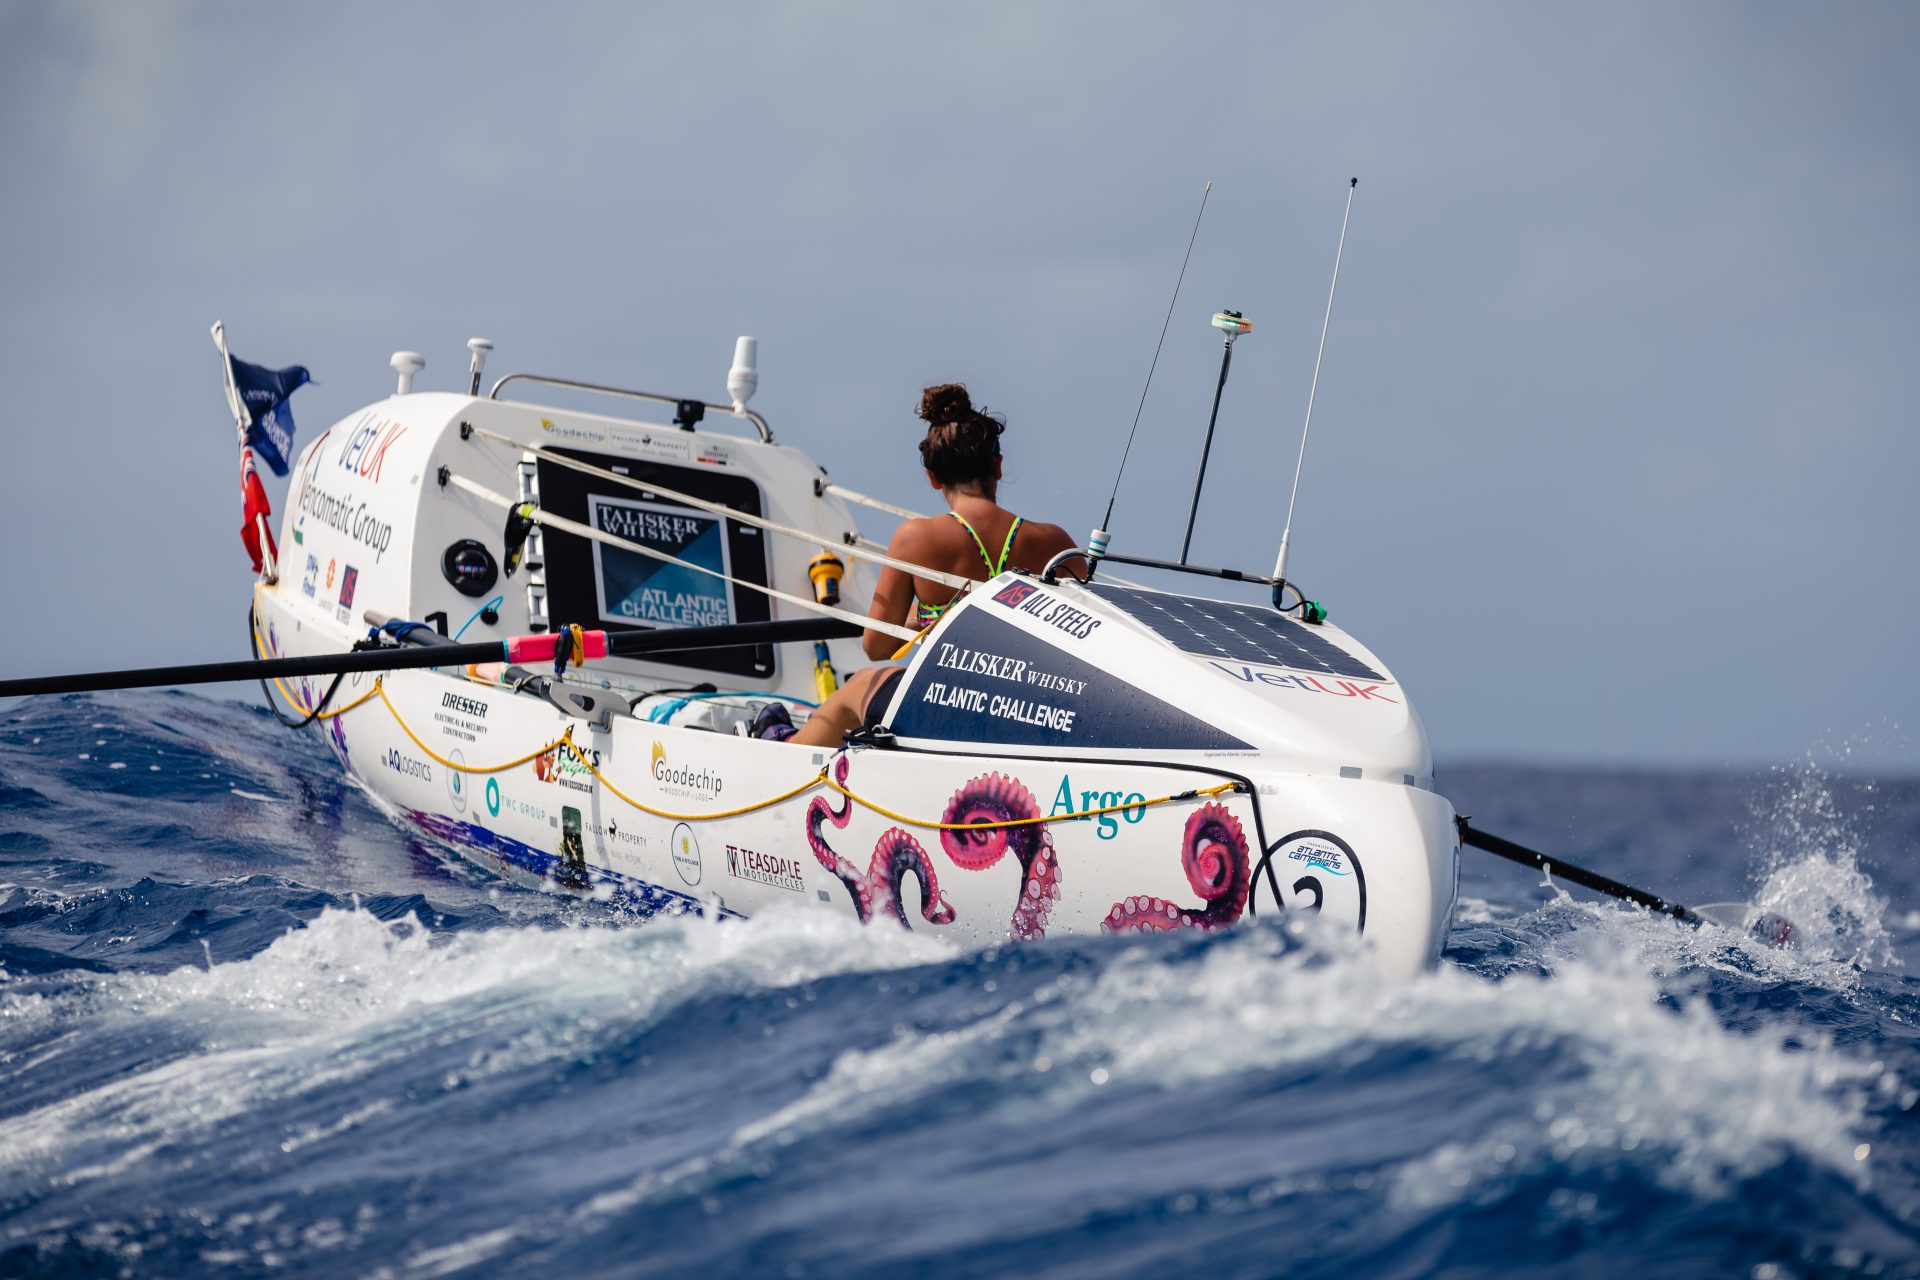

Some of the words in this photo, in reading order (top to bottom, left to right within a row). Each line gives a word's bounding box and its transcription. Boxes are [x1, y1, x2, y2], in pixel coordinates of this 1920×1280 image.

[338, 410, 409, 484] VetUK
[298, 471, 354, 536] Vencomatic
[353, 502, 392, 565] Group
[598, 505, 700, 535] TALISKER
[604, 521, 686, 544] WHISKY
[621, 600, 729, 627] CHALLENGE
[641, 588, 728, 614] ATLANTIC
[1020, 593, 1051, 618] ALL
[1043, 603, 1102, 640] STEELS
[936, 643, 1027, 683] TALISKER
[1027, 670, 1088, 696] WHISKY
[1207, 661, 1400, 704] VetUK
[441, 692, 488, 718] DRESSER
[922, 682, 988, 713] ATLANTIC
[989, 695, 1076, 732] CHALLENGE
[442, 726, 476, 742] CONTRACTORS
[465, 721, 488, 735] SECURITY
[655, 760, 722, 798] Goodechip
[501, 795, 517, 811] TWC
[520, 803, 546, 820] GROUP
[1047, 774, 1147, 840] Argo
[585, 822, 608, 836] FALLOW
[618, 831, 647, 848] PROPERTY
[740, 848, 803, 880] TEASDALE
[743, 868, 805, 891] MOTORCYCLES
